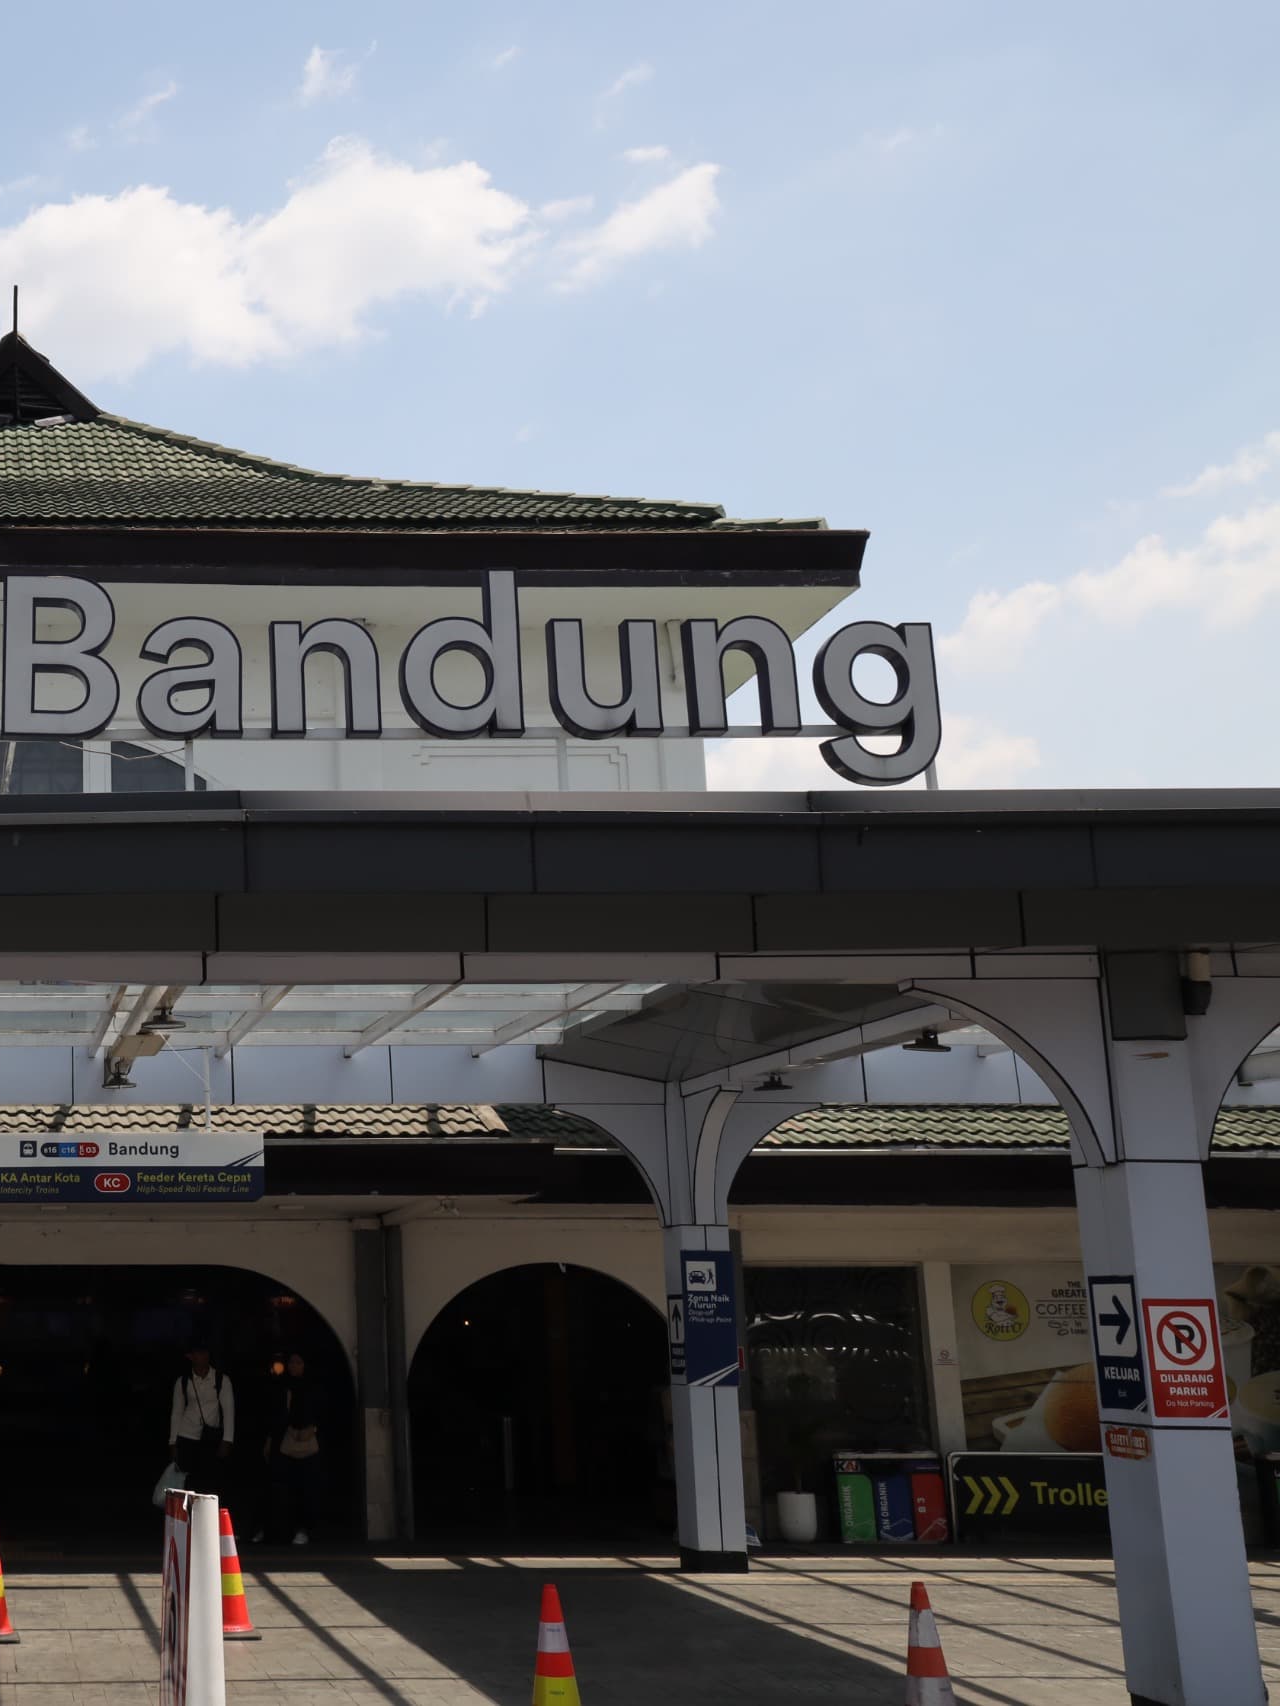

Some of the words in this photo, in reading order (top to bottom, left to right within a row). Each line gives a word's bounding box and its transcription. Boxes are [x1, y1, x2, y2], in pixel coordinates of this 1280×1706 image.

[2, 569, 942, 786] Bandung
[108, 1141, 180, 1159] Bandung
[0, 1173, 18, 1183] KA
[20, 1173, 52, 1183] Antar
[55, 1173, 81, 1183] Kota
[103, 1178, 121, 1188] KC
[136, 1172, 175, 1183] Feeder
[178, 1172, 215, 1182] Kereta
[217, 1172, 252, 1185] Cepat
[0, 1185, 33, 1195] Intercity
[35, 1185, 60, 1193] Trains
[136, 1184, 183, 1195] High-Speed
[185, 1184, 201, 1193] Rail
[203, 1184, 230, 1193] Feeder
[232, 1184, 249, 1193] Line
[1067, 1281, 1081, 1289] THE
[688, 1294, 709, 1303] Zona
[710, 1295, 730, 1303] Naik
[1035, 1303, 1087, 1316] COFFEE
[1104, 1366, 1141, 1382] KELUAR
[1160, 1373, 1214, 1384] DILARANG
[1169, 1386, 1209, 1397] PARKIR
[1166, 1400, 1176, 1408] Do
[1190, 1400, 1215, 1409] Parking
[878, 1481, 890, 1517] ORGANIK
[1030, 1481, 1109, 1507] Trolle
[841, 1485, 854, 1527] ORGANIK
